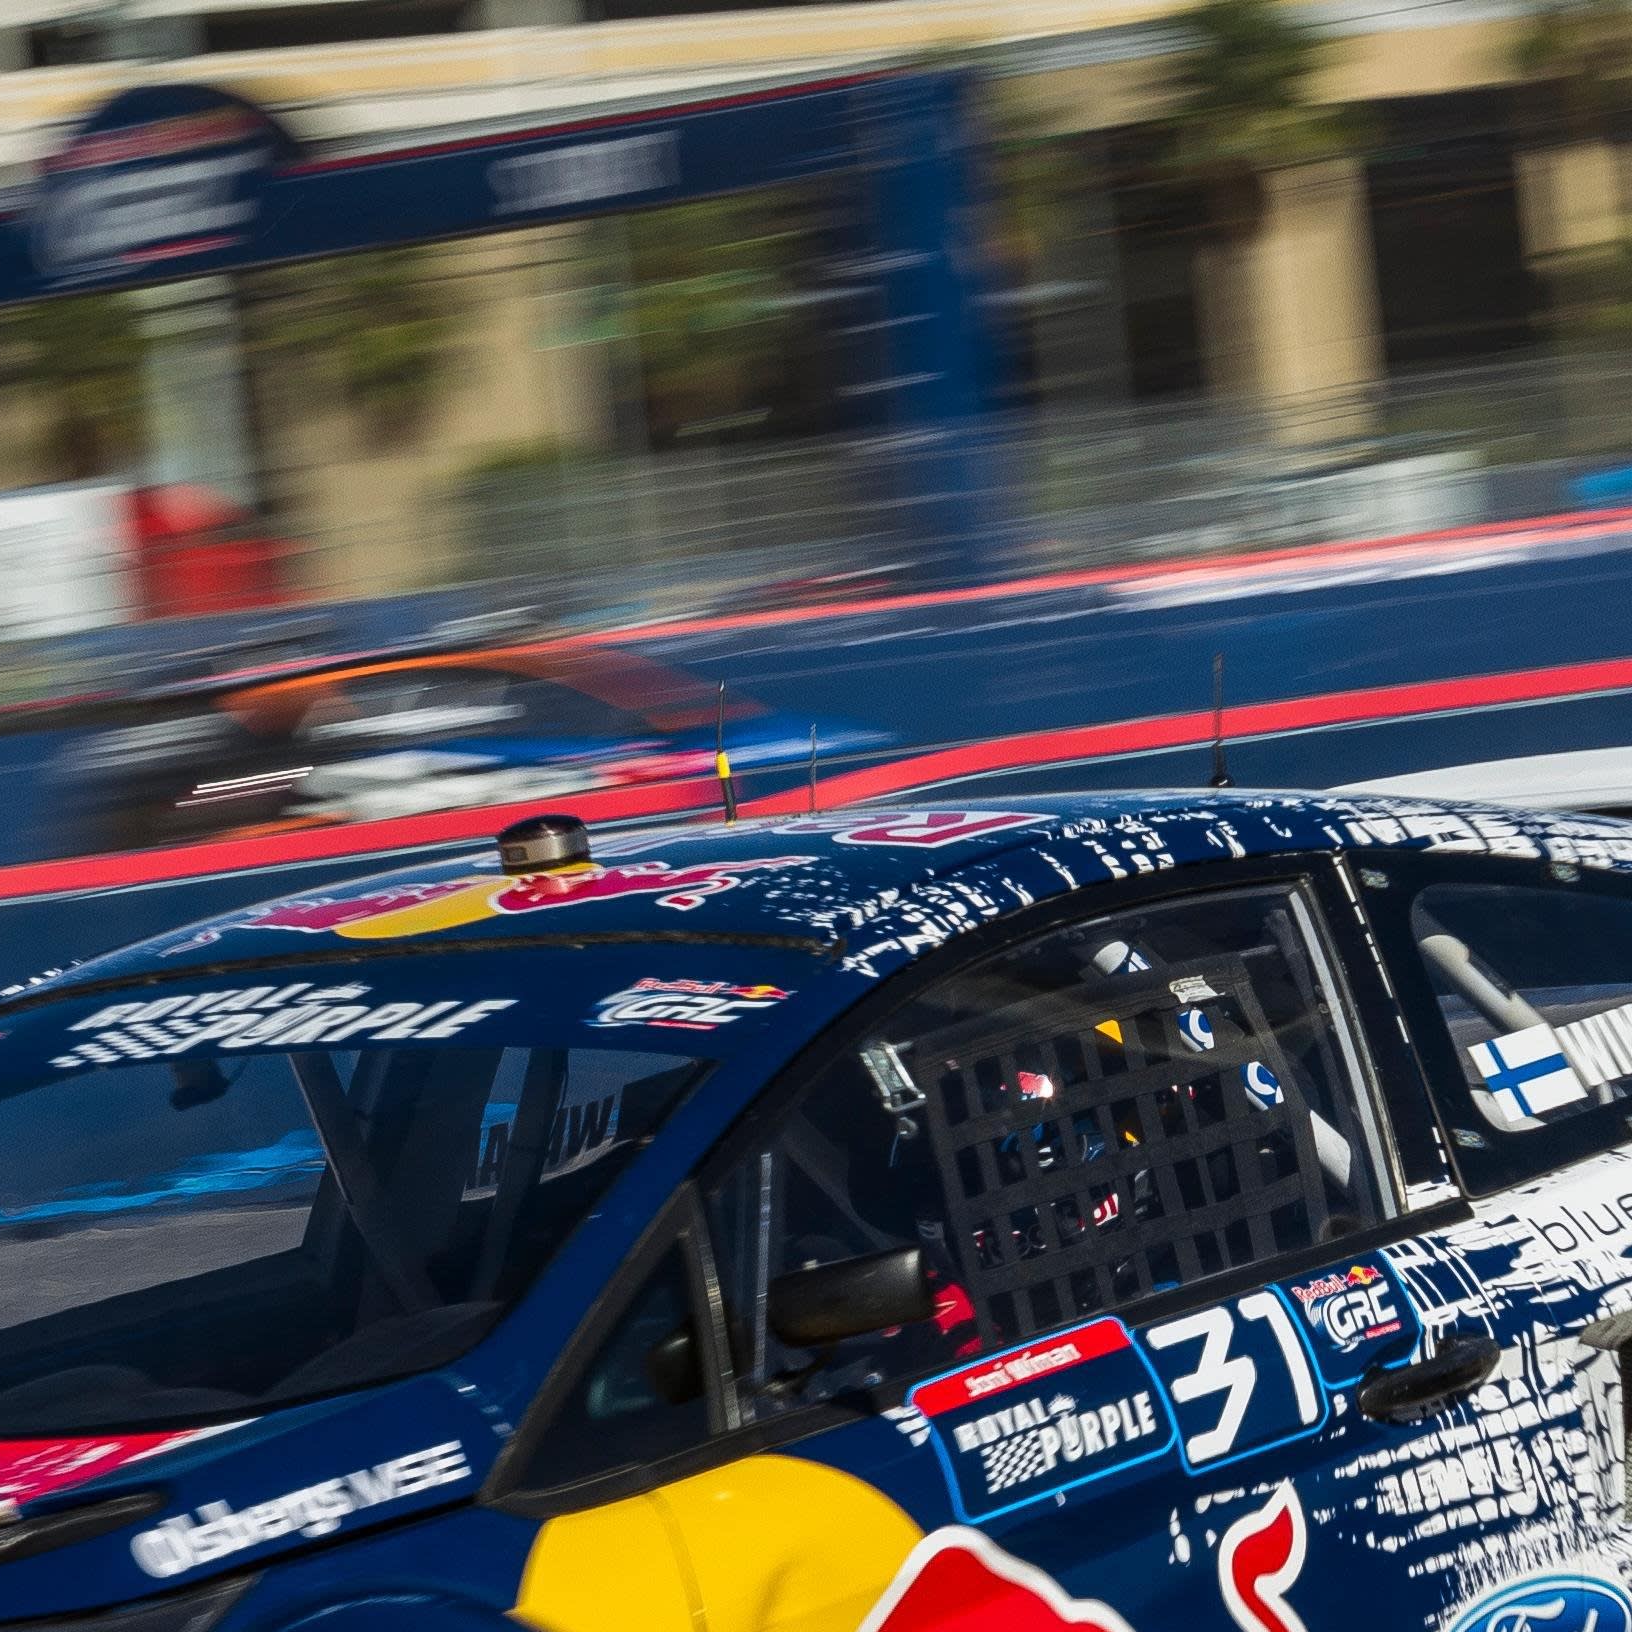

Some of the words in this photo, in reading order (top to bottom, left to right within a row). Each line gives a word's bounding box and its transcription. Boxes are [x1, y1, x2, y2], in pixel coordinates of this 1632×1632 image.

[1146, 1291, 1318, 1464] 31
[952, 1397, 1050, 1453] ROYAL
[1038, 1390, 1156, 1472] PURPLE
